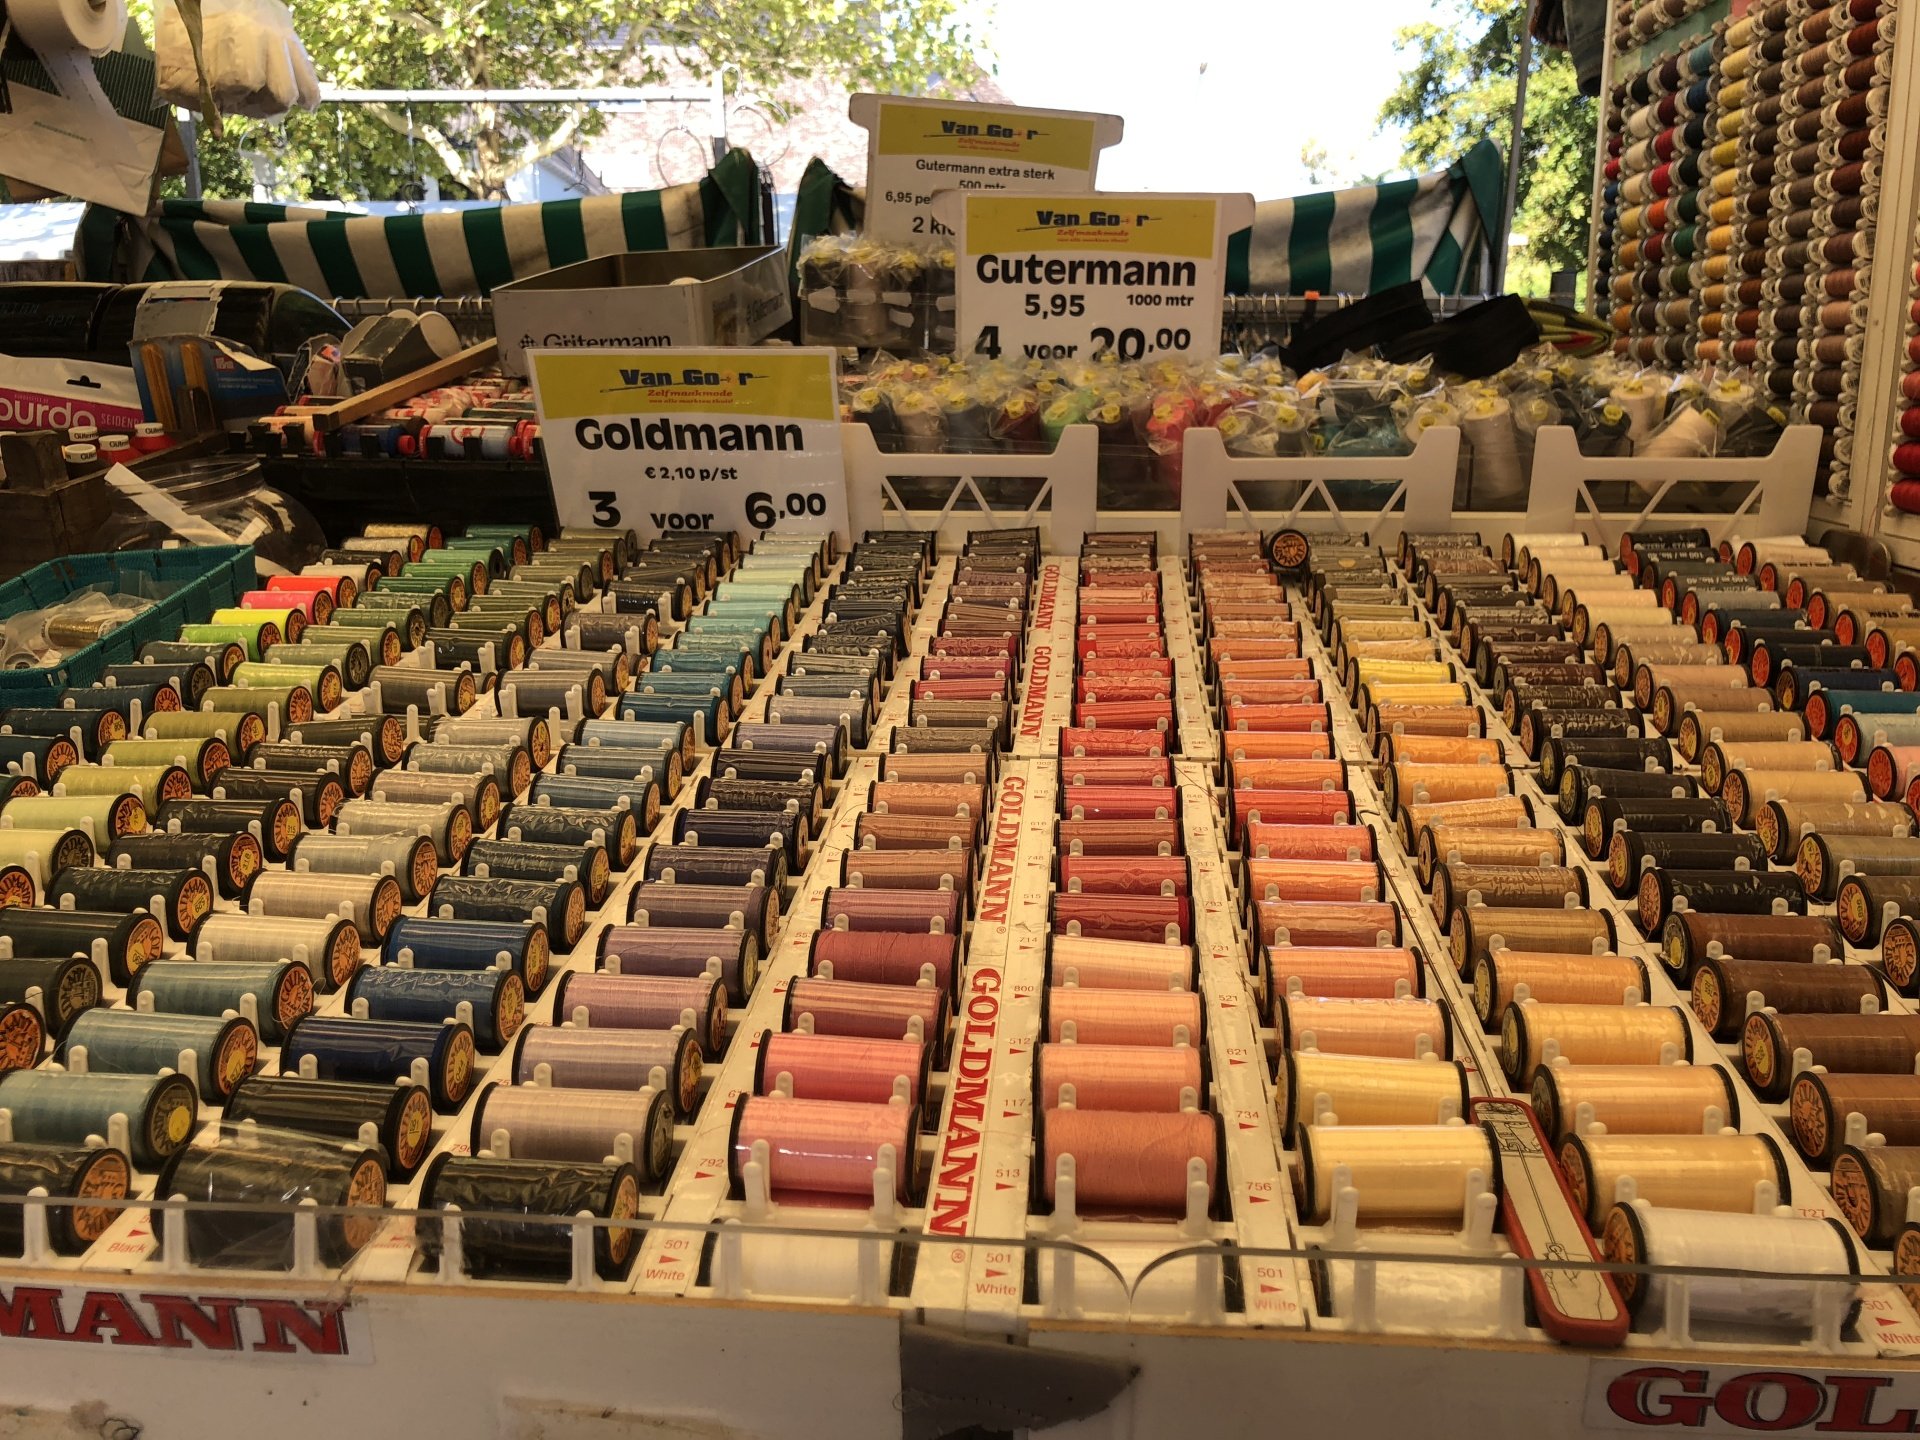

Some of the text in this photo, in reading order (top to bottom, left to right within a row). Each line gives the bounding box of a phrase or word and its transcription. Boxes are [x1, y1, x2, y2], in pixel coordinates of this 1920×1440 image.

[941, 120, 979, 136] Van
[915, 159, 1055, 181] Gutermann extra sterk
[885, 192, 931, 206] 6,95 pe
[1036, 210, 1080, 226] Van
[912, 218, 924, 234] 2
[976, 253, 1197, 287] Gutermann
[1025, 294, 1194, 322] 5,95 1000 mtr
[975, 325, 1192, 362] 4 voor 20,00
[619, 368, 673, 387] Van
[574, 417, 804, 451] Goldmann
[660, 467, 695, 481] 2,10
[699, 467, 738, 481] p/st
[588, 490, 827, 530] 3 voor 6,00
[1035, 564, 1060, 630] GOLDMANN
[1021, 646, 1052, 739] GOLDMANN
[979, 776, 1026, 924] GOLDMANN
[1218, 994, 1239, 1002] 521
[1008, 1037, 1031, 1045] 512
[1226, 1048, 1248, 1056] 621
[929, 966, 1002, 1237] GOLDMANN
[1003, 1098, 1026, 1107] 117
[1236, 1110, 1260, 1119] 734
[699, 1157, 724, 1168] 792
[995, 1169, 1020, 1178] 513
[1245, 1181, 1273, 1191] 756
[1798, 1207, 1826, 1218] 727
[107, 1241, 146, 1253] Black
[663, 1239, 690, 1249] 501
[986, 1252, 1012, 1263] 501
[645, 1268, 686, 1281] White
[1256, 1267, 1284, 1278] 501
[975, 1282, 1017, 1296] White
[1253, 1300, 1298, 1314] White
[1864, 1300, 1894, 1311] 501
[1606, 1366, 1920, 1434] GOL
